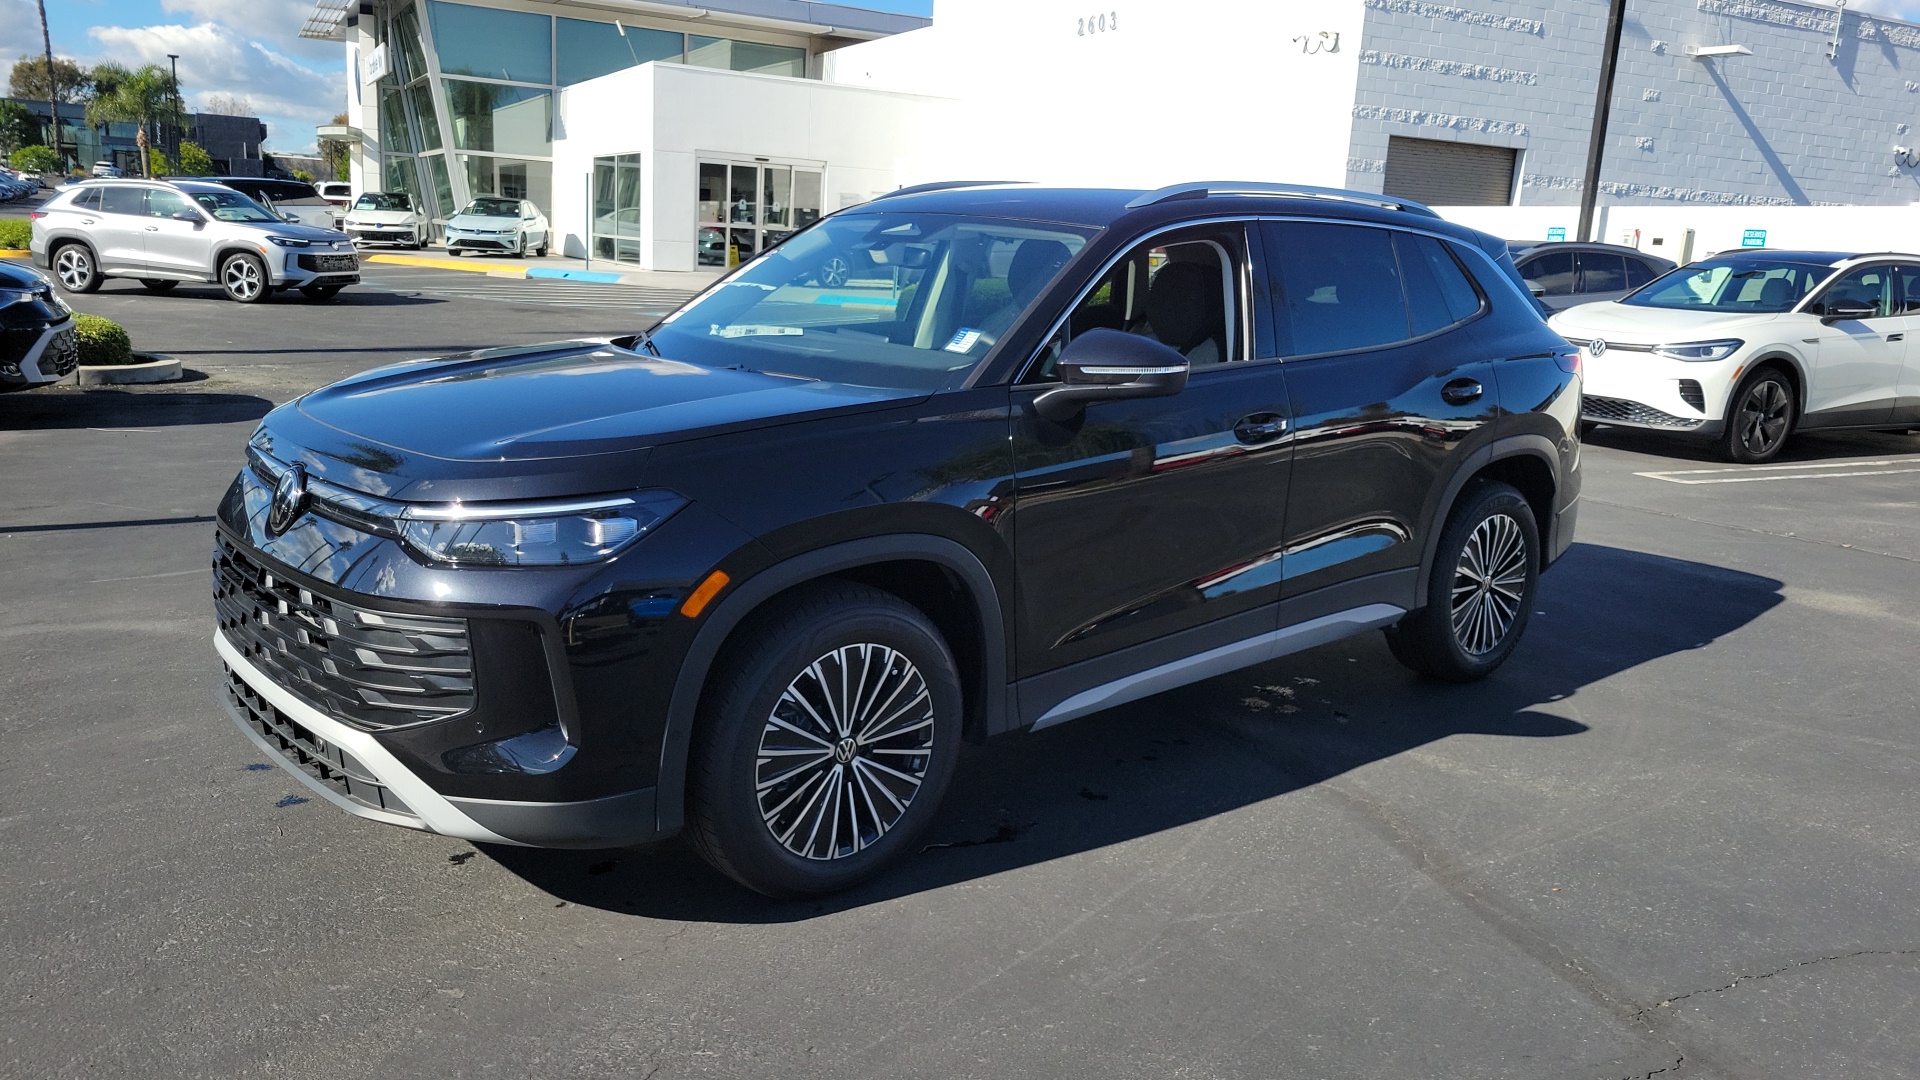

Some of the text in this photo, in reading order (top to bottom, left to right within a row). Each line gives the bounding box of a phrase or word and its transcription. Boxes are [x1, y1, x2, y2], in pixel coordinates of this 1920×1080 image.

[1077, 11, 1117, 36] 2603
[1743, 238, 1764, 246] PARKING
[1744, 230, 1766, 238] RESERVED
[1589, 338, 1606, 358] VW
[836, 738, 857, 763] VW
